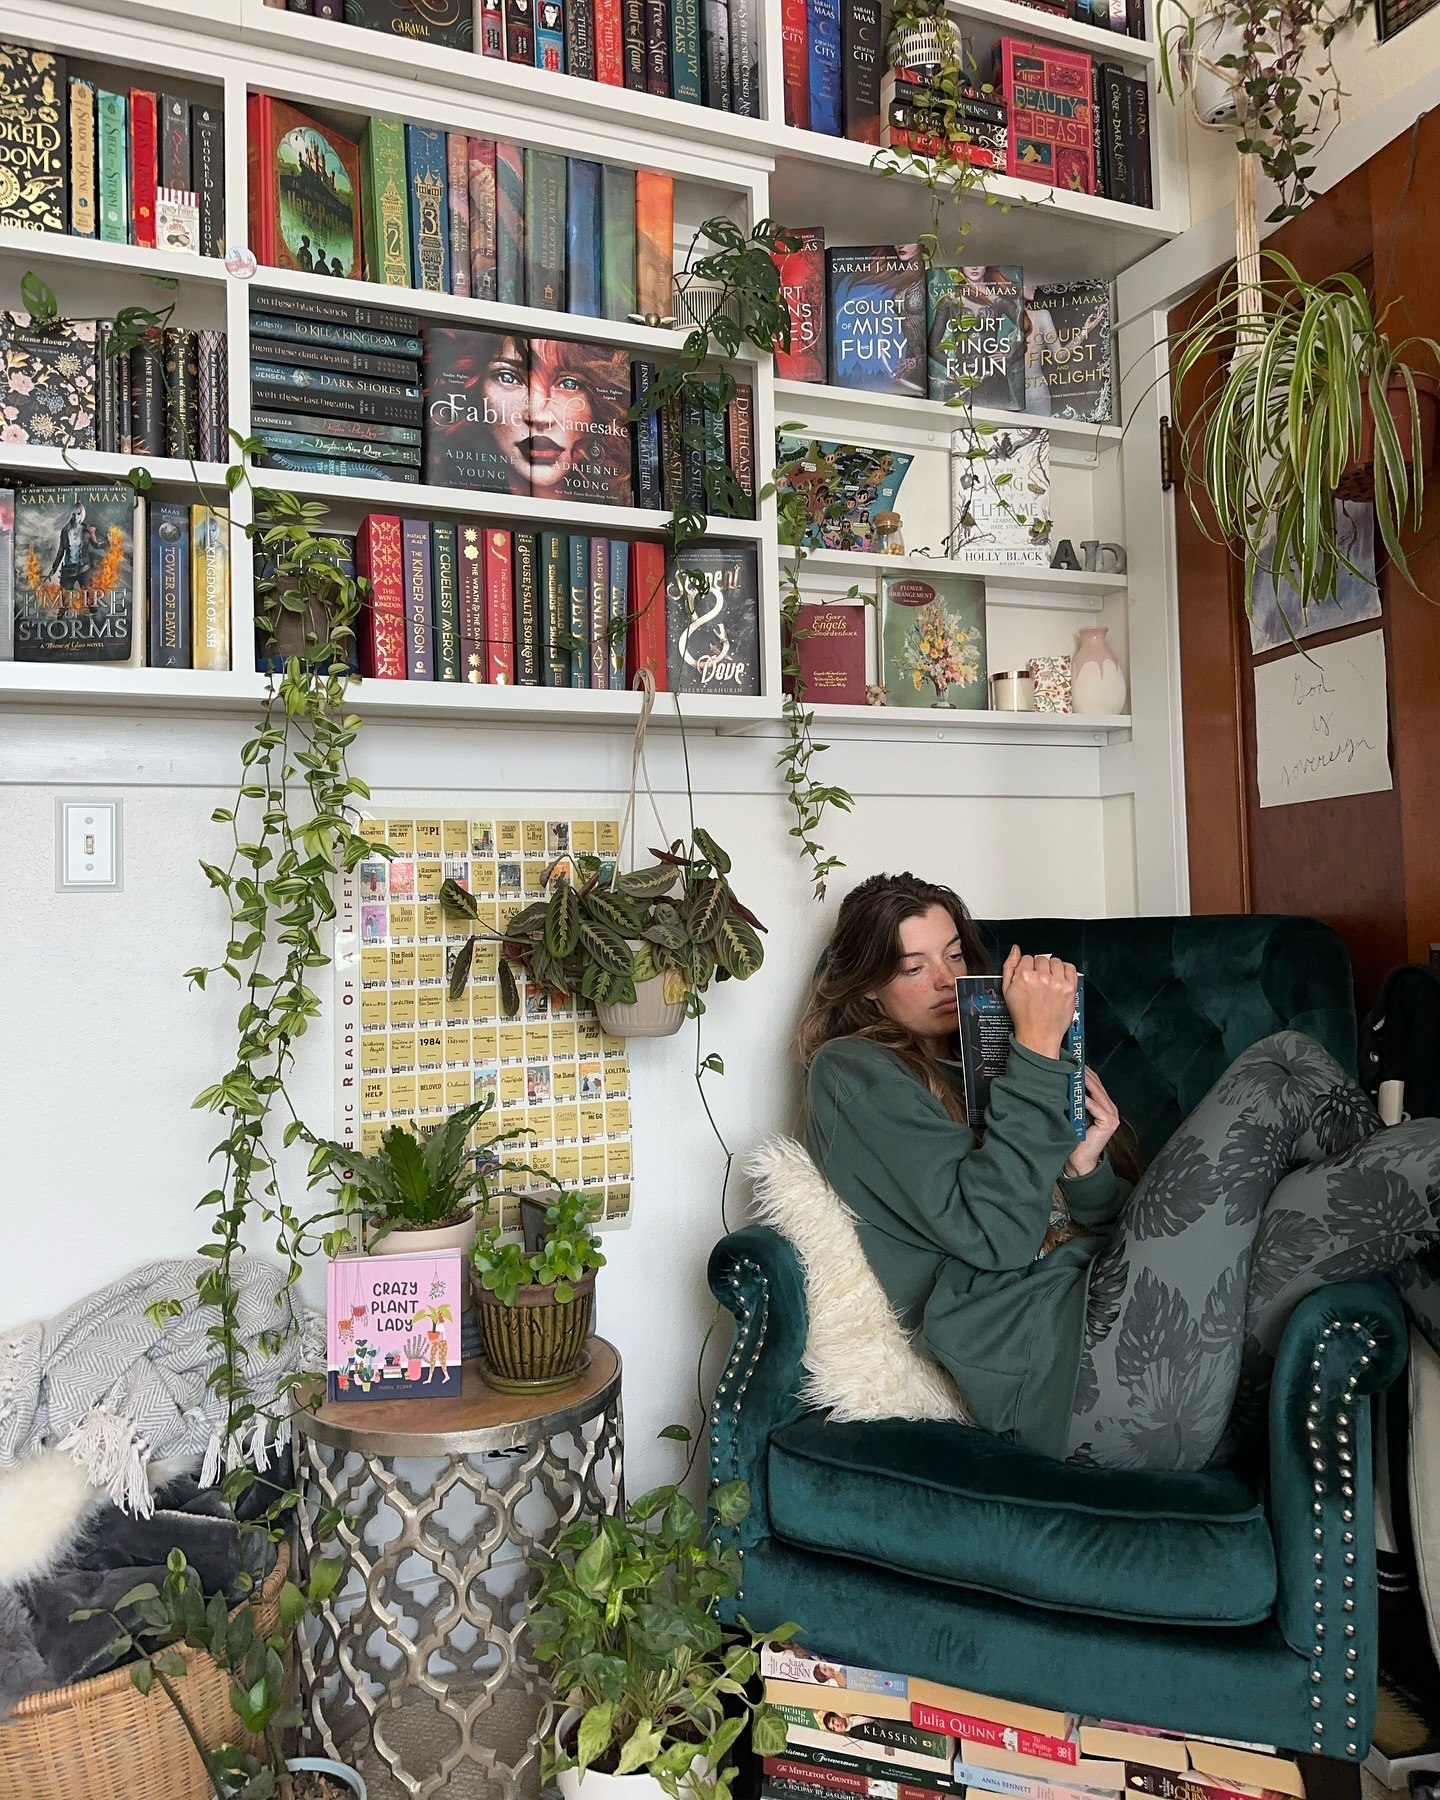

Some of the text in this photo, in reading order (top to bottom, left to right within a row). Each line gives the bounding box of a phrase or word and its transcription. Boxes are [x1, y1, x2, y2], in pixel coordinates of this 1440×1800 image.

[814, 5, 835, 20] MAAS
[853, 12, 875, 25] MAAS
[391, 18, 430, 36] CARAVAL
[675, 13, 686, 54] GLASS
[577, 16, 586, 68] THIEVES
[604, 18, 614, 70] THIEVES
[782, 31, 804, 44] CITY
[626, 38, 643, 73] Flame
[650, 38, 667, 73] Stars
[815, 45, 836, 59] CITY
[853, 44, 875, 54] CRESCENT
[853, 51, 875, 64] CITY
[688, 54, 698, 77] IVY
[741, 46, 751, 98] STAR CURSED
[957, 101, 989, 116] WOLF KING
[1015, 86, 1078, 117] BEAUTY
[1035, 116, 1088, 145] BEAST
[1111, 83, 1128, 185] CURSE DARK LONELY
[76, 107, 90, 193] SHADOW BONE
[105, 123, 119, 207] SIEGE STORM
[201, 130, 214, 254] CROOKED KINGDOM
[424, 209, 437, 234] 3
[387, 226, 399, 256] 2
[832, 262, 919, 274] SARAH J. MAAS
[985, 286, 1017, 296] MAAS
[1072, 294, 1103, 305] MAAS
[271, 299, 348, 317] these black sands
[844, 300, 905, 315] COURT
[255, 320, 283, 331] CHRISTO
[309, 324, 397, 347] KILL KINGDOM
[853, 317, 907, 336] MIST
[6, 333, 71, 347] Mdame Bovary
[1034, 327, 1091, 345] COURT
[252, 343, 350, 364] from these dark depths
[842, 338, 907, 360] FURY
[1028, 344, 1097, 369] FROST
[255, 372, 286, 381] JENSEN
[946, 357, 1007, 377] RUIN
[178, 348, 186, 413] The Tenant Wildfell
[320, 375, 401, 395] DARK SHORES
[641, 364, 649, 392] JENSEN
[1025, 368, 1104, 389] STARLIGHT
[278, 393, 355, 410] these last breaths
[430, 393, 523, 427] Fable
[254, 416, 293, 426] LEVENSELLER
[543, 398, 629, 438] Namesake
[736, 396, 752, 497] DEATHCASTER
[446, 450, 516, 464] ADRIENNE
[456, 465, 505, 480] YOUNG
[554, 461, 619, 476] ADRIENNE
[642, 465, 651, 490] HEIR
[563, 476, 609, 491] YOUNG
[21, 493, 127, 504] SARAH J. MAAS
[965, 551, 1042, 561] HOLLY BLACK
[471, 563, 479, 576] THE
[165, 547, 176, 648] TOWER OF DAWN
[205, 546, 216, 648] KINGDOM OF ASH
[471, 577, 480, 603] WRATH
[548, 564, 557, 611] SONGBIRDS
[20, 588, 128, 619] EMPIRE
[378, 594, 401, 602] WOVEN
[411, 558, 425, 654] KINDER POISON
[439, 554, 454, 664] CRUELEST MERCY
[518, 545, 533, 674] HOUSE SALT SORROWS
[571, 587, 587, 642] DEFY
[594, 581, 606, 642] IGNITE
[19, 617, 128, 641] STORMS
[812, 620, 847, 630] Engels
[64, 642, 71, 650] of
[71, 641, 86, 650] Glass
[697, 655, 745, 685] Dove
[1292, 673, 1335, 705] God
[1310, 713, 1333, 740] is
[429, 827, 440, 835] PI
[578, 1025, 585, 1033] ON
[420, 1038, 441, 1046] 1984
[343, 980, 354, 1150] EPIC READS OF
[1073, 1081, 1083, 1122] HEALER
[373, 1281, 418, 1297] CRAZY
[371, 1300, 419, 1315] PLANT
[377, 1318, 413, 1332] LADY
[779, 1662, 811, 1680] QUINN
[788, 1658, 804, 1667] JULIA
[863, 1725, 918, 1745] KLASSEN
[919, 1711, 996, 1740] Julia QUINN
[812, 1752, 859, 1768] Forevermore
[1038, 1750, 1052, 1758] Love
[776, 1764, 861, 1787] The MISTLETOE COUNTESS
[982, 1777, 1032, 1794] ANNA BENNETT
[825, 1791, 855, 1800] GASLIGHT
